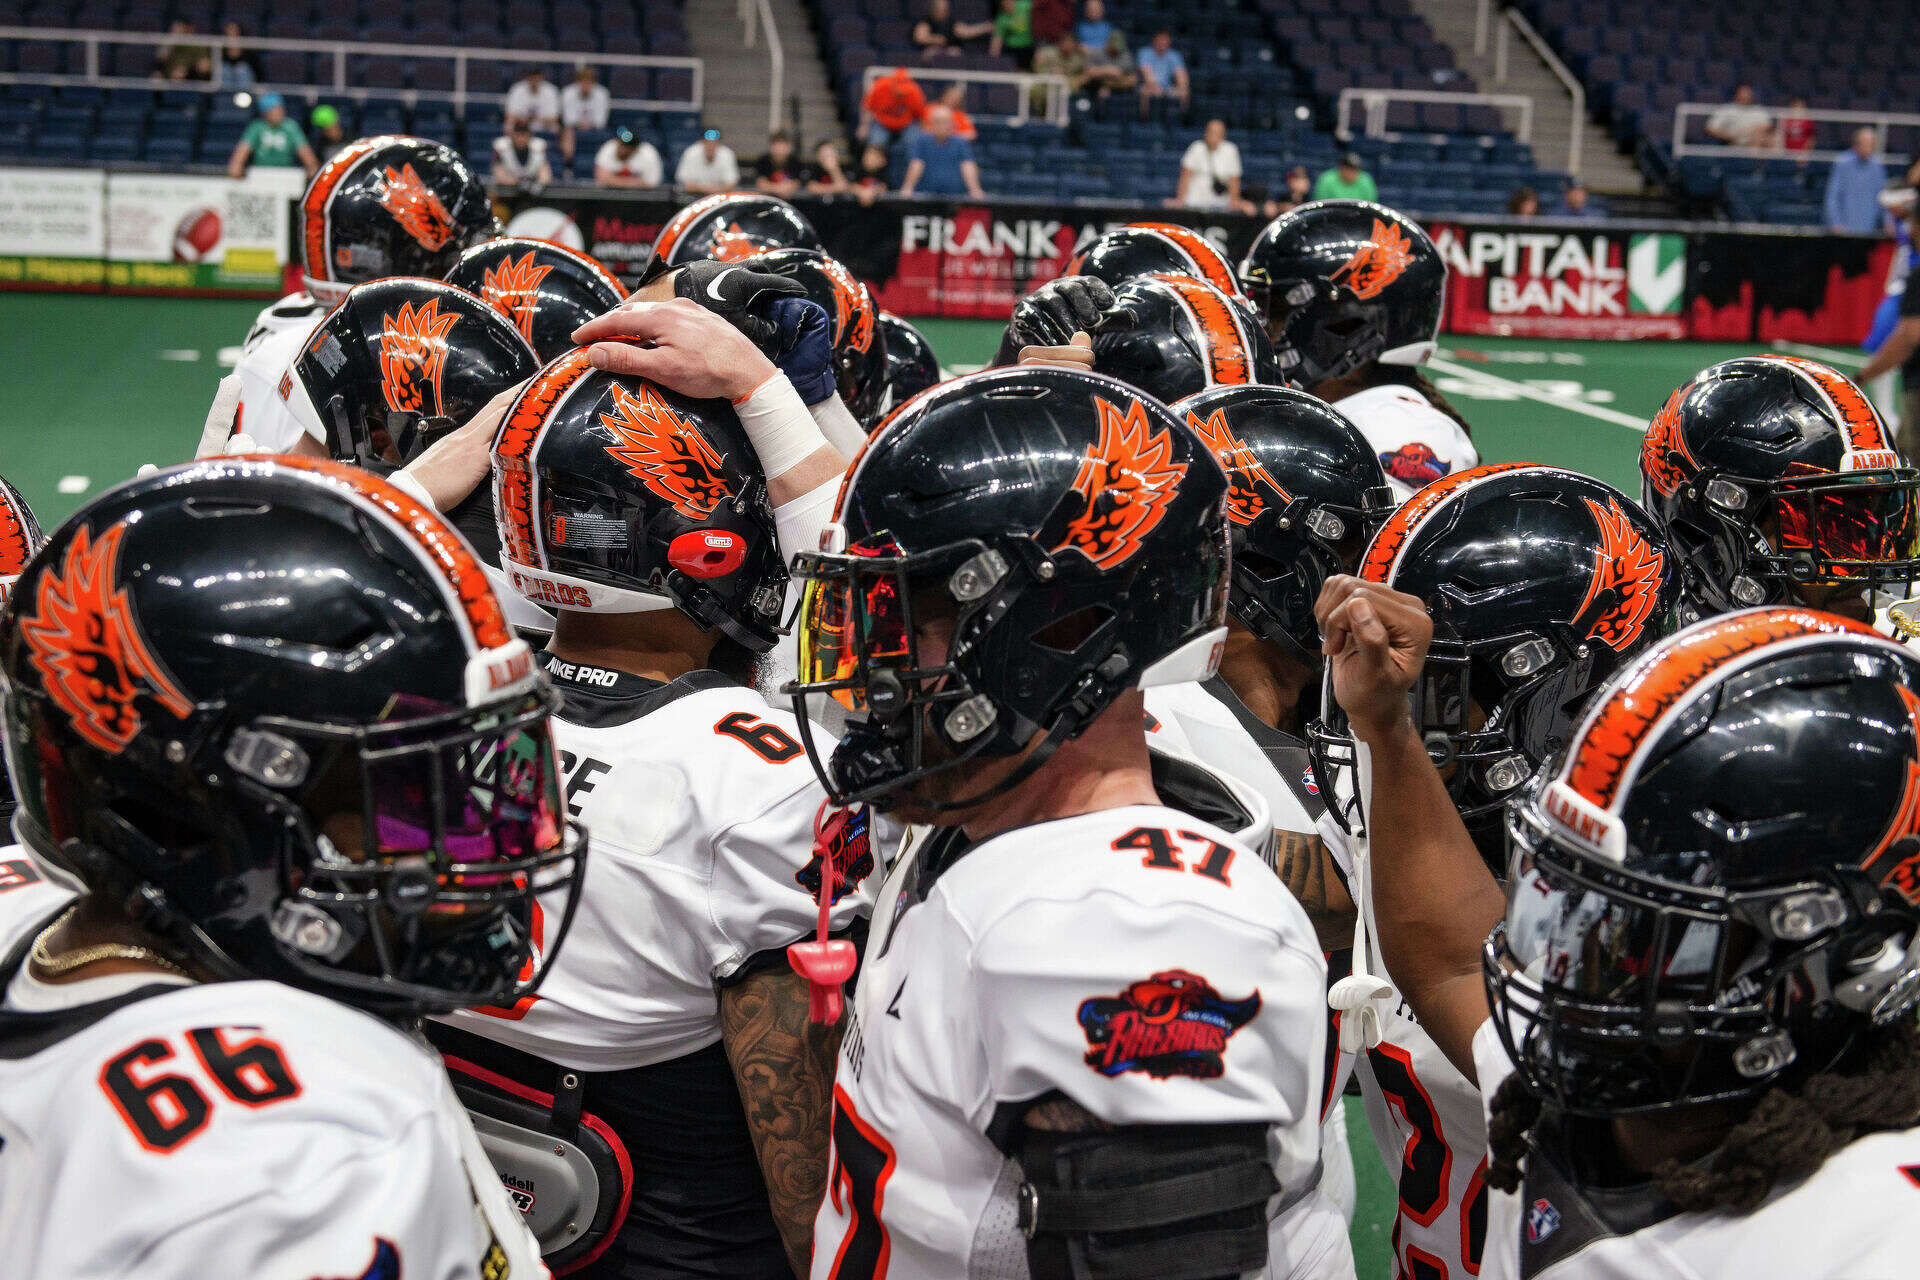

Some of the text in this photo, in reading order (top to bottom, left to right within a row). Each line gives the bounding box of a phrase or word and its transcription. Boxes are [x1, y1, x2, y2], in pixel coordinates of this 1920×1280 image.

[902, 214, 1061, 258] FRANK
[1433, 228, 1626, 284] APITAL
[1489, 275, 1626, 317] BANK
[1852, 453, 1898, 469] ALBANY
[573, 512, 604, 520] WARNING
[545, 656, 619, 688] NIKE PRO
[713, 711, 806, 765] 6
[1110, 826, 1237, 888] 47
[98, 1024, 303, 1155] 66
